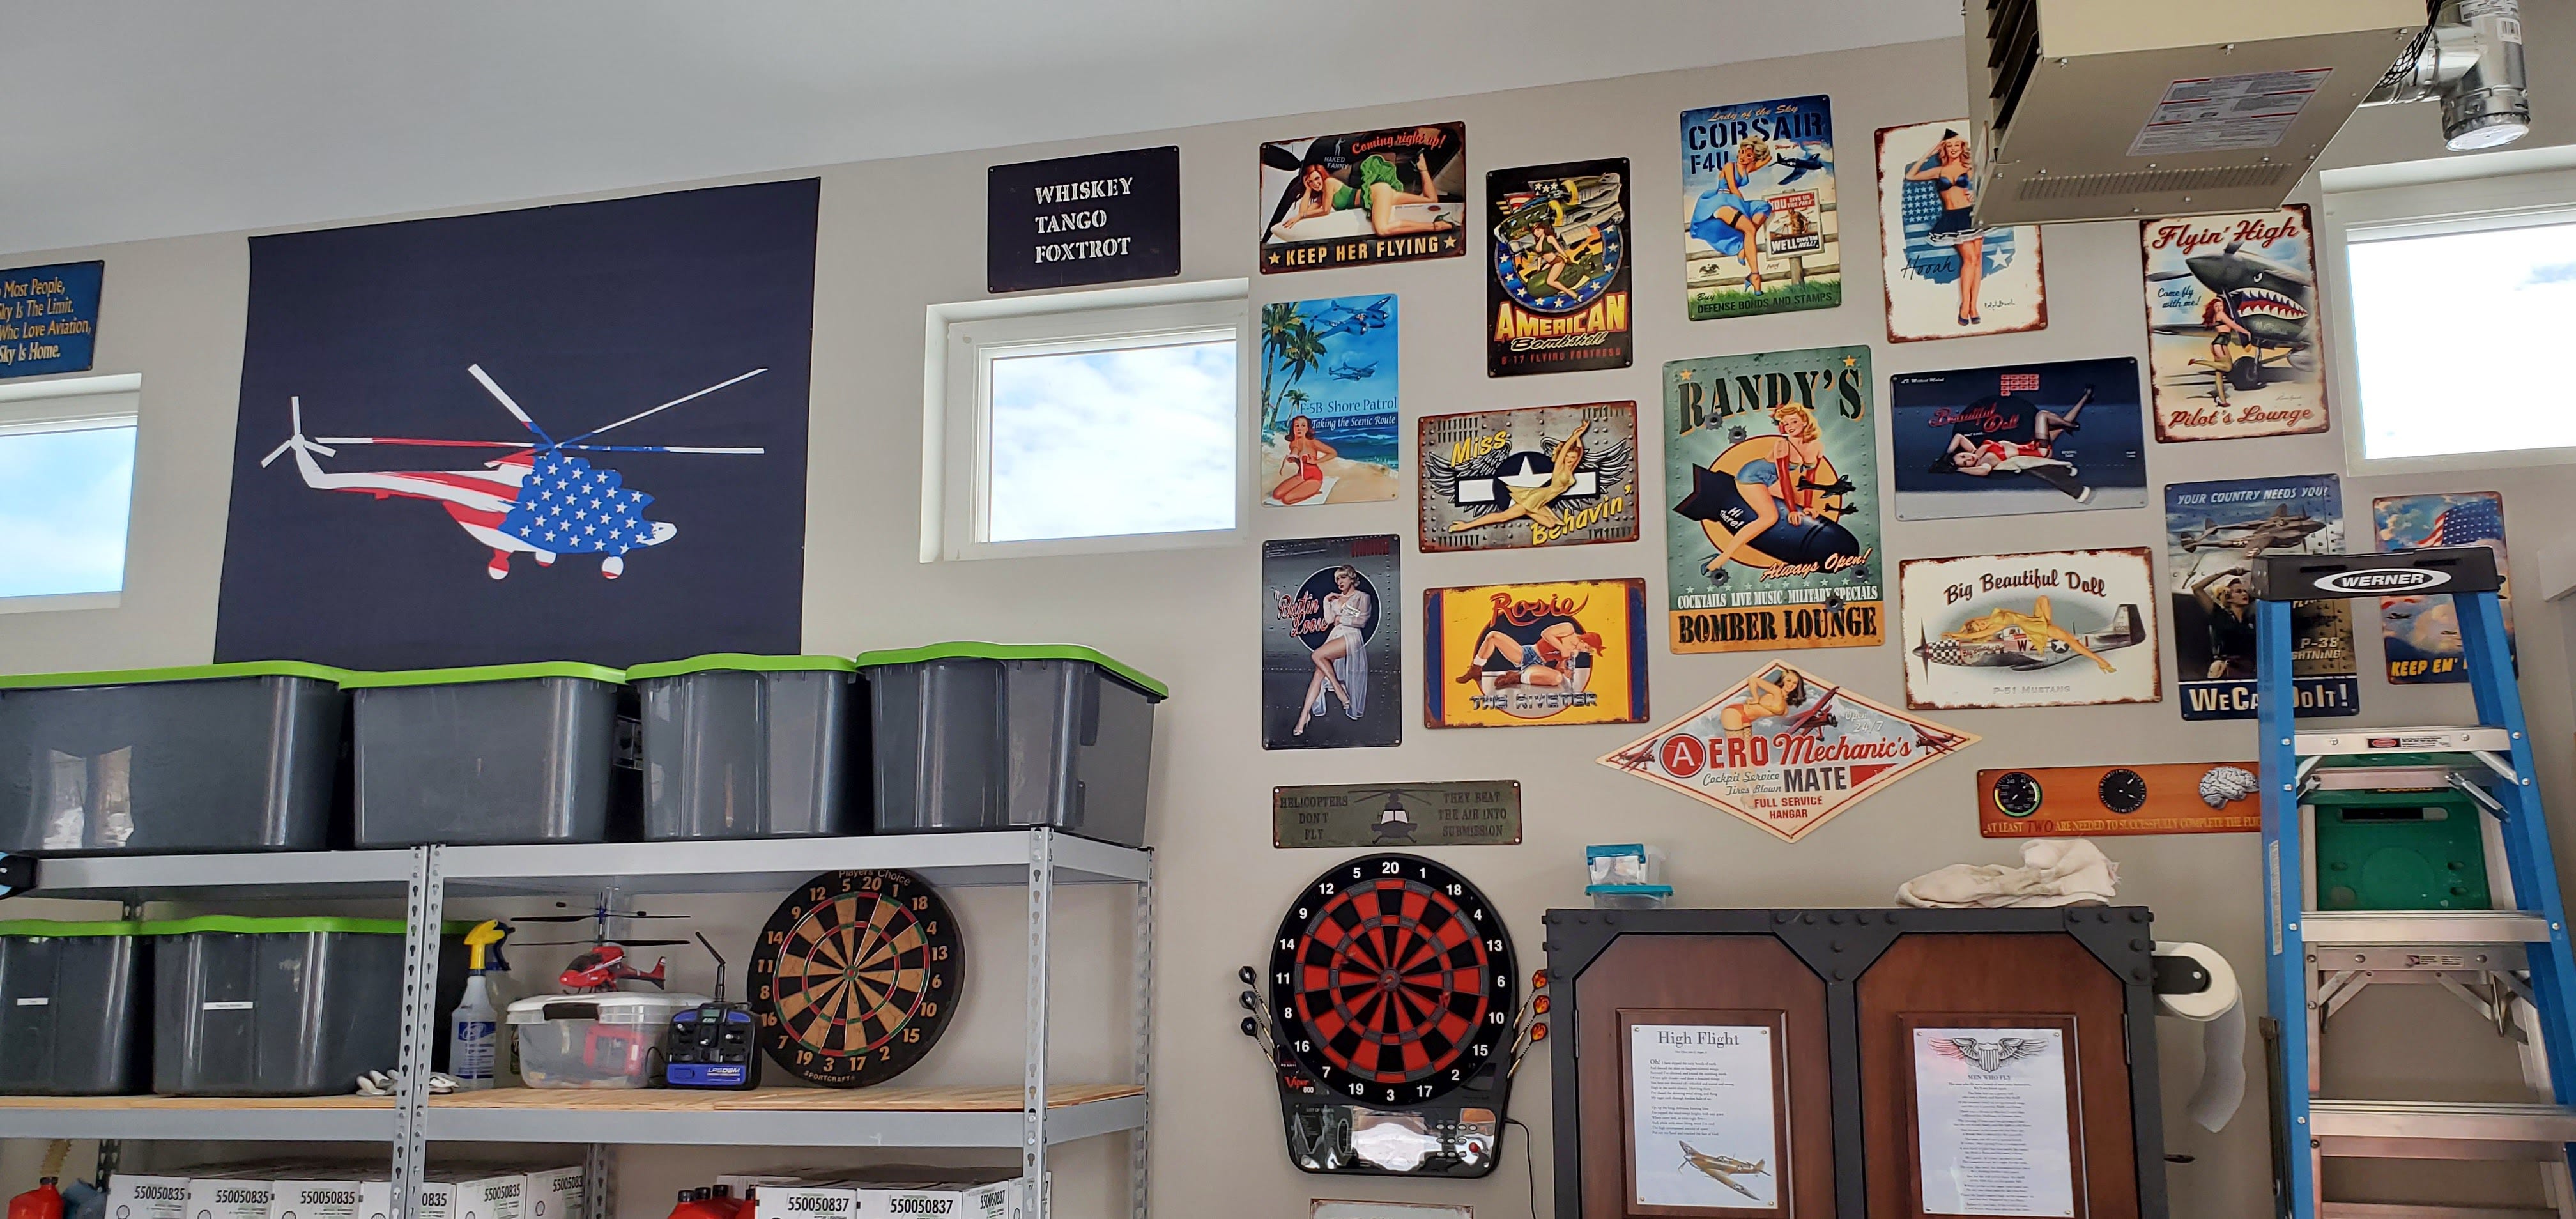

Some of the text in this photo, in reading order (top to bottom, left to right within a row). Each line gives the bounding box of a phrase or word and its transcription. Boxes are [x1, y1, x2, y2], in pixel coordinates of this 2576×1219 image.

[1708, 105, 1798, 122] Lady of the Sky
[1689, 112, 1822, 150] CORSAIR
[1352, 137, 1393, 154] Coming
[1427, 134, 1446, 149] up!
[1690, 151, 1729, 174] F4U
[1035, 177, 1133, 204] WHISKEY
[1035, 210, 1106, 233] TANGO
[2152, 217, 2300, 254] Flyin' High
[1035, 238, 1131, 263] FOXTROT
[1286, 236, 1438, 266] KEEP HER FLYING
[4, 276, 65, 298] Most People,
[2158, 288, 2193, 298] Come fly
[1696, 292, 1715, 302] Buy
[1698, 293, 1832, 313] DEFENSE BONDS AND STAMPS
[2162, 296, 2201, 309] with me!
[16, 296, 73, 318] Is The Limit.
[1494, 291, 1628, 341] AMERICAN
[23, 322, 45, 338] Love
[1511, 332, 1608, 351] Bombshell
[18, 342, 26, 361] Is
[29, 342, 61, 360] Home.
[1300, 397, 1397, 414] F-5B Shore Patrol
[1678, 369, 1864, 437] RANDY'S
[1928, 402, 1997, 427] Beautiful
[2168, 405, 2311, 427] Pilot's Lounge
[1312, 416, 1395, 431] Taking the Scenic Route
[1984, 414, 2019, 432] Doll
[1451, 431, 1508, 467] Miss
[2177, 486, 2328, 505] YOUR COUNTRY NEEDS YOU!
[1530, 484, 1632, 546] Behavin'
[1728, 507, 1742, 517] Hi
[1760, 548, 1873, 582] Always Open!
[1944, 568, 2106, 605] Big Beautiful Doll
[2342, 574, 2424, 588] WERNER
[1678, 586, 1878, 609] COCKTAILS LIVE MUSIC MILITARY SPECIALS
[1490, 592, 1589, 627] Rosie
[1291, 611, 1329, 638] Loose
[1678, 606, 1877, 643] BOMBER LOUNGE
[2301, 637, 2340, 648] P-38
[2391, 657, 2458, 677] KEEP EM'
[1993, 686, 2070, 695] P-51 MUSTANG
[1469, 692, 1597, 710] THE RIVETER
[1844, 711, 1867, 719] Open
[1853, 721, 1883, 733] 24/7
[1773, 733, 1912, 765] Mechanic's
[1703, 770, 1779, 786] Cockpit Service
[1783, 767, 1846, 793] MATE
[1443, 792, 1500, 803] THEY BEAT
[1725, 785, 1781, 795] Tires Blown
[1280, 795, 1347, 808] HELICOPTERS
[1754, 796, 1823, 808] FULL SERVICE
[1438, 809, 1506, 820] THE AIR INTO
[1770, 809, 1807, 819] HANGAR
[1443, 825, 1503, 837] SUBMISSION
[1987, 816, 2241, 832] AT LEAST TWO ARE NEEDED TO SUCCESSFULLY COMPLETE THE
[1305, 829, 1323, 839] FLY
[1353, 867, 1361, 878] 5
[1382, 862, 1399, 875] 20
[1420, 867, 1426, 878] 1
[878, 869, 910, 885] Choice
[1319, 883, 1333, 894] 12
[1446, 884, 1462, 895] 18
[1300, 908, 1307, 919] 9
[1474, 909, 1482, 920] 4
[1280, 939, 1294, 950] 14
[1487, 940, 1503, 951] 13
[1276, 973, 1290, 984] 11
[1497, 976, 1505, 986] 6
[1284, 1008, 1292, 1018] 8
[1489, 1013, 1504, 1024] 10
[1294, 1041, 1310, 1052] 16
[1657, 1031, 1739, 1048] High Flight
[1473, 1045, 1488, 1056] 15
[1322, 1066, 1330, 1078] 7
[1452, 1070, 1459, 1080] 2
[1349, 1084, 1364, 1096] 19
[1387, 1090, 1394, 1101] 3
[1417, 1086, 1432, 1097] 17
[135, 1185, 185, 1200] 550050835
[216, 1190, 268, 1204] 550050835
[300, 1191, 355, 1204] 550050835
[485, 1184, 520, 1202] 550050835
[980, 1190, 1005, 1209] 550050837
[788, 1197, 848, 1212] 550050837
[891, 1199, 953, 1214] 550050837
